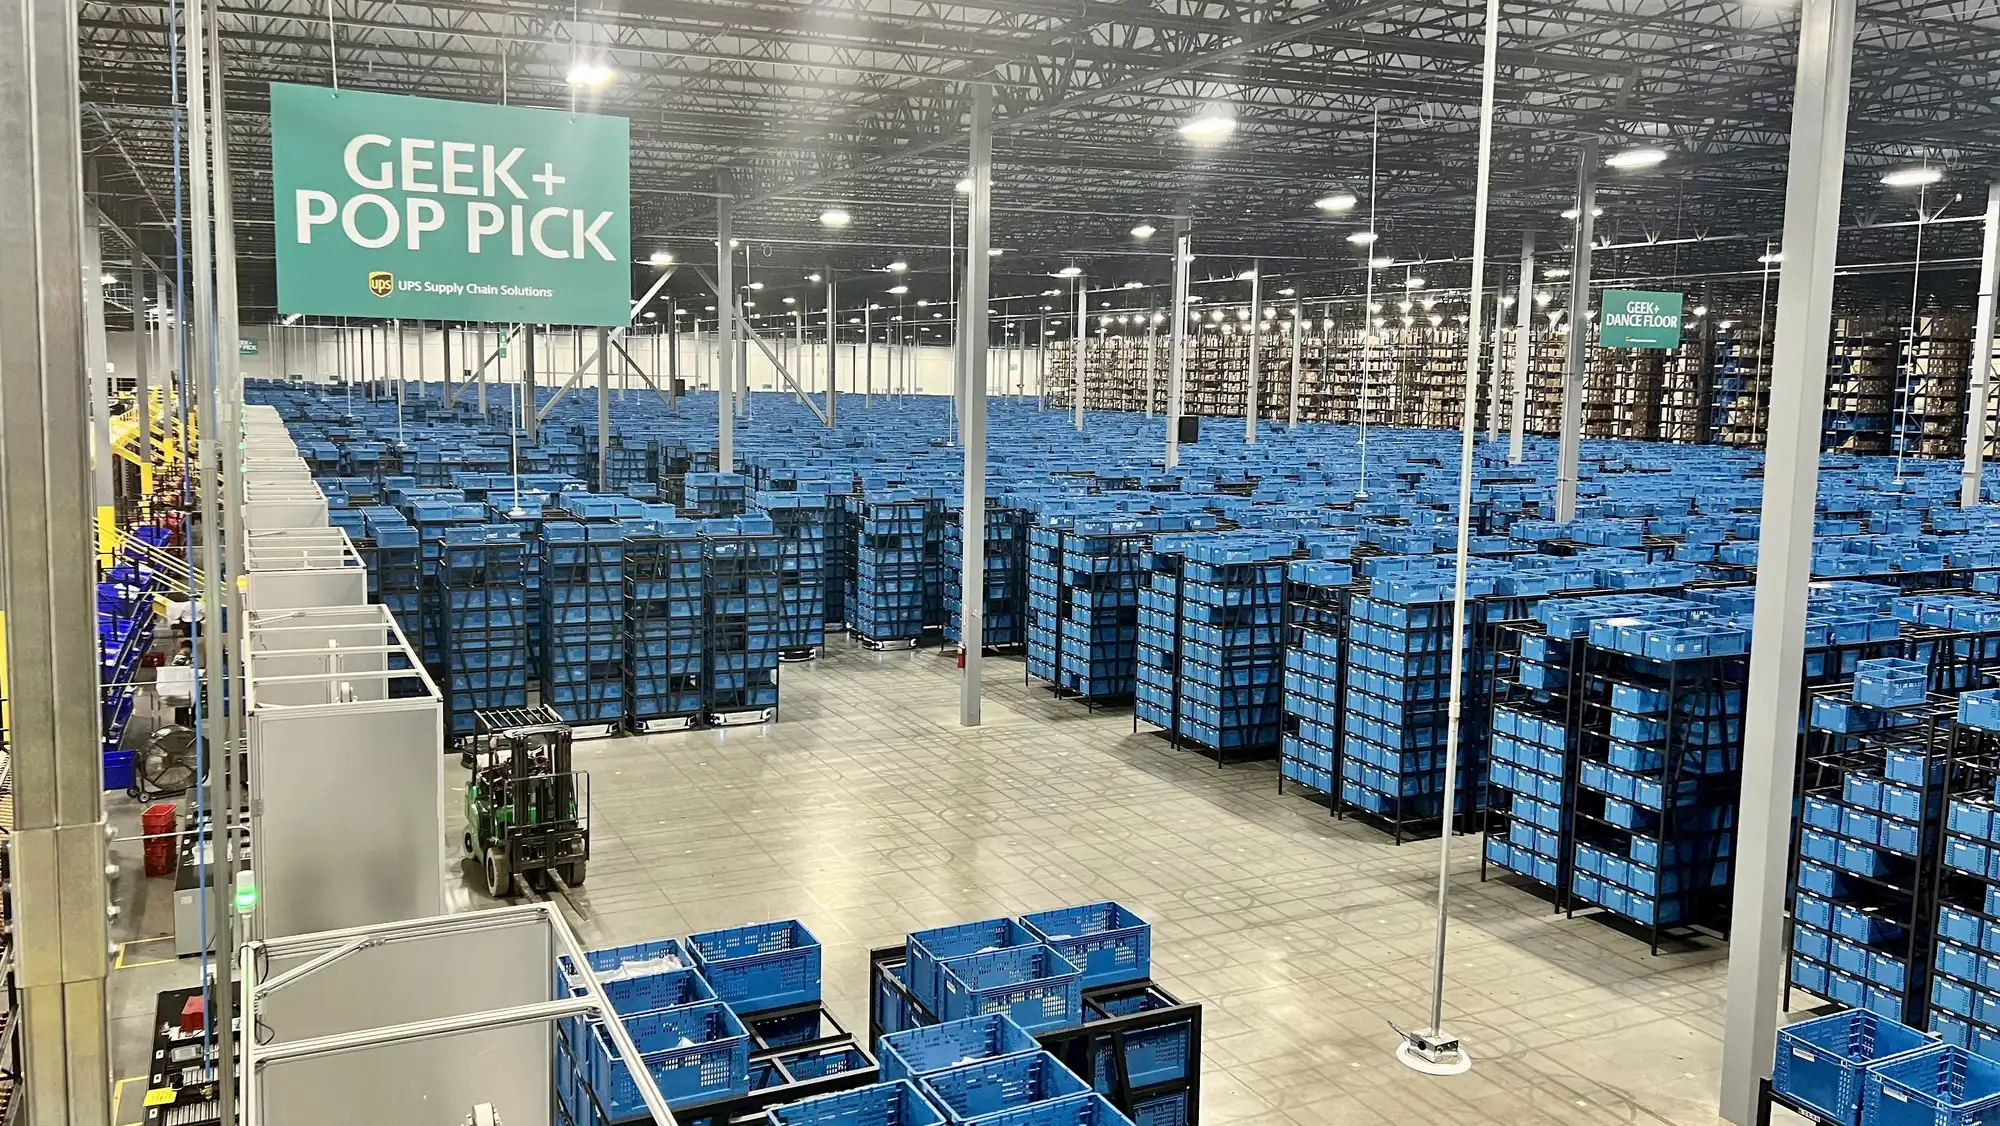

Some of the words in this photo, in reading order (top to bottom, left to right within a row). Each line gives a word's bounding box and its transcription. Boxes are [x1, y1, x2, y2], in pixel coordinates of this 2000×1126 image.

[343, 133, 566, 200] GEEK+
[295, 188, 446, 251] POP
[467, 201, 618, 262] PICK
[371, 279, 392, 294] ups
[398, 280, 423, 292] UPS
[424, 281, 464, 296] Supply
[466, 283, 499, 295] Chain
[500, 285, 553, 298] Solutions
[1626, 301, 1659, 314] GEEK+
[1606, 313, 1642, 327] DANCE
[1643, 315, 1677, 328] FLOOR
